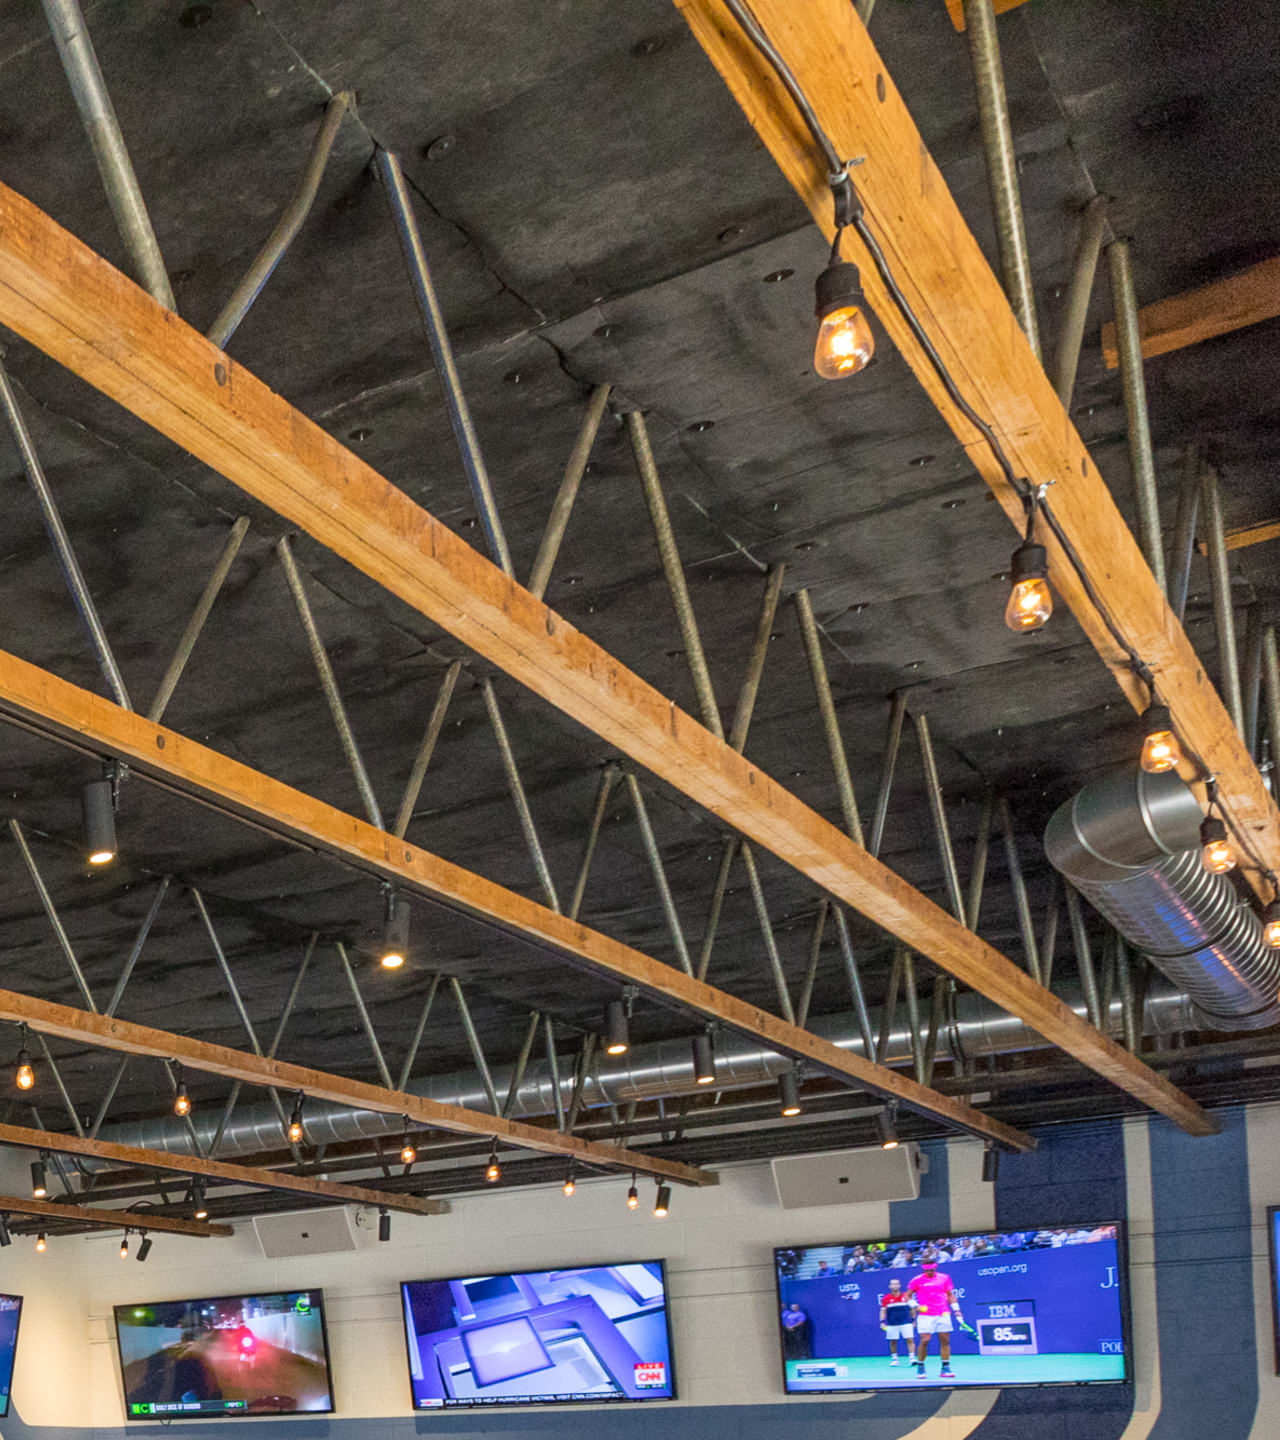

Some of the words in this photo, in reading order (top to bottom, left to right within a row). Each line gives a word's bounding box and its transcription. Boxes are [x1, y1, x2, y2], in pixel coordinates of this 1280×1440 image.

[978, 1262, 1027, 1277] usopen.org
[1101, 1266, 1120, 1288] J.
[840, 1283, 860, 1292] USTA
[989, 1305, 1016, 1318] IBM
[638, 1372, 661, 1381] CNN
